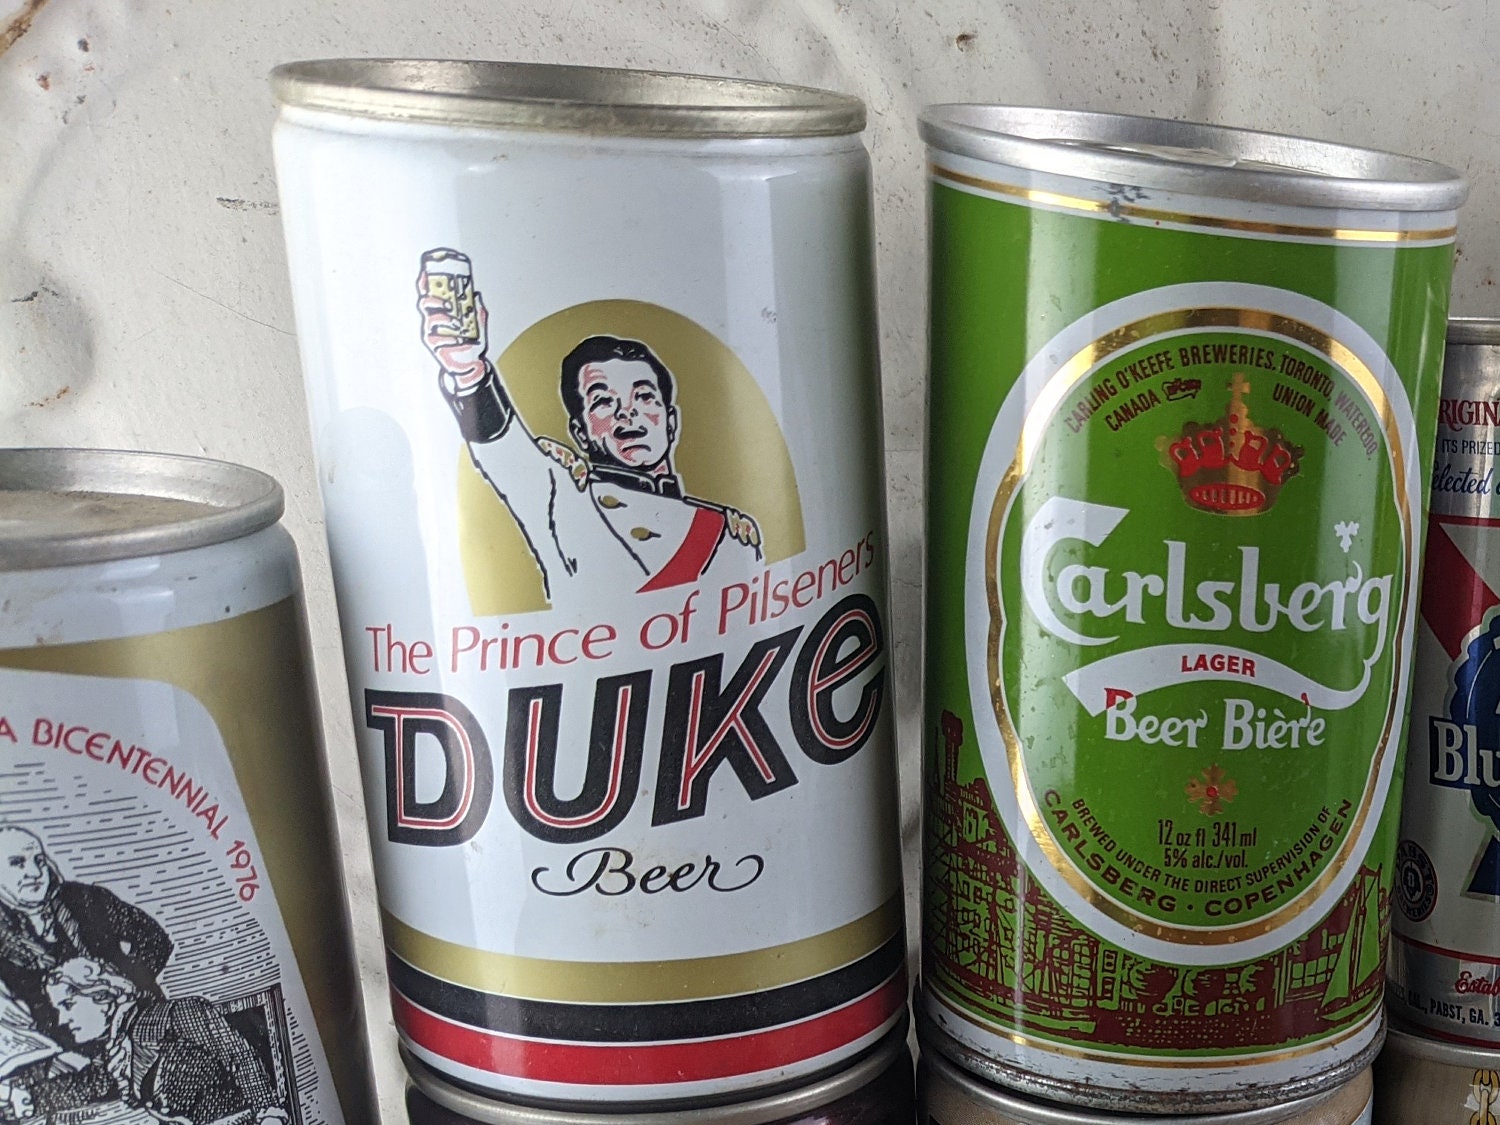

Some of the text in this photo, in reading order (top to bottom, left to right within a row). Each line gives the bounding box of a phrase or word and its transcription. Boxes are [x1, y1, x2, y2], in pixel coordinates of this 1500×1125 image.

[1117, 350, 1175, 390] O'KEEFE
[1104, 388, 1162, 432] CANADA
[1272, 382, 1349, 448] UNION MADE
[1461, 440, 1500, 456] PRIZED
[1431, 462, 1494, 496] elected
[365, 530, 877, 676] The Prince of Pilseners
[1019, 495, 1395, 668] Carlsberg
[1180, 653, 1256, 678] LAGER
[1103, 687, 1327, 752] Beer Bière
[31, 720, 261, 903] BICENTENNIAL 1976
[1211, 820, 1237, 848] 341
[531, 847, 765, 897] Beer
[1043, 788, 1178, 914] CARLSBERG
[1203, 797, 1354, 918] COPENHAGEN
[1072, 798, 1320, 894] BREWED UNDER THE DIRECT SUPERVISION
